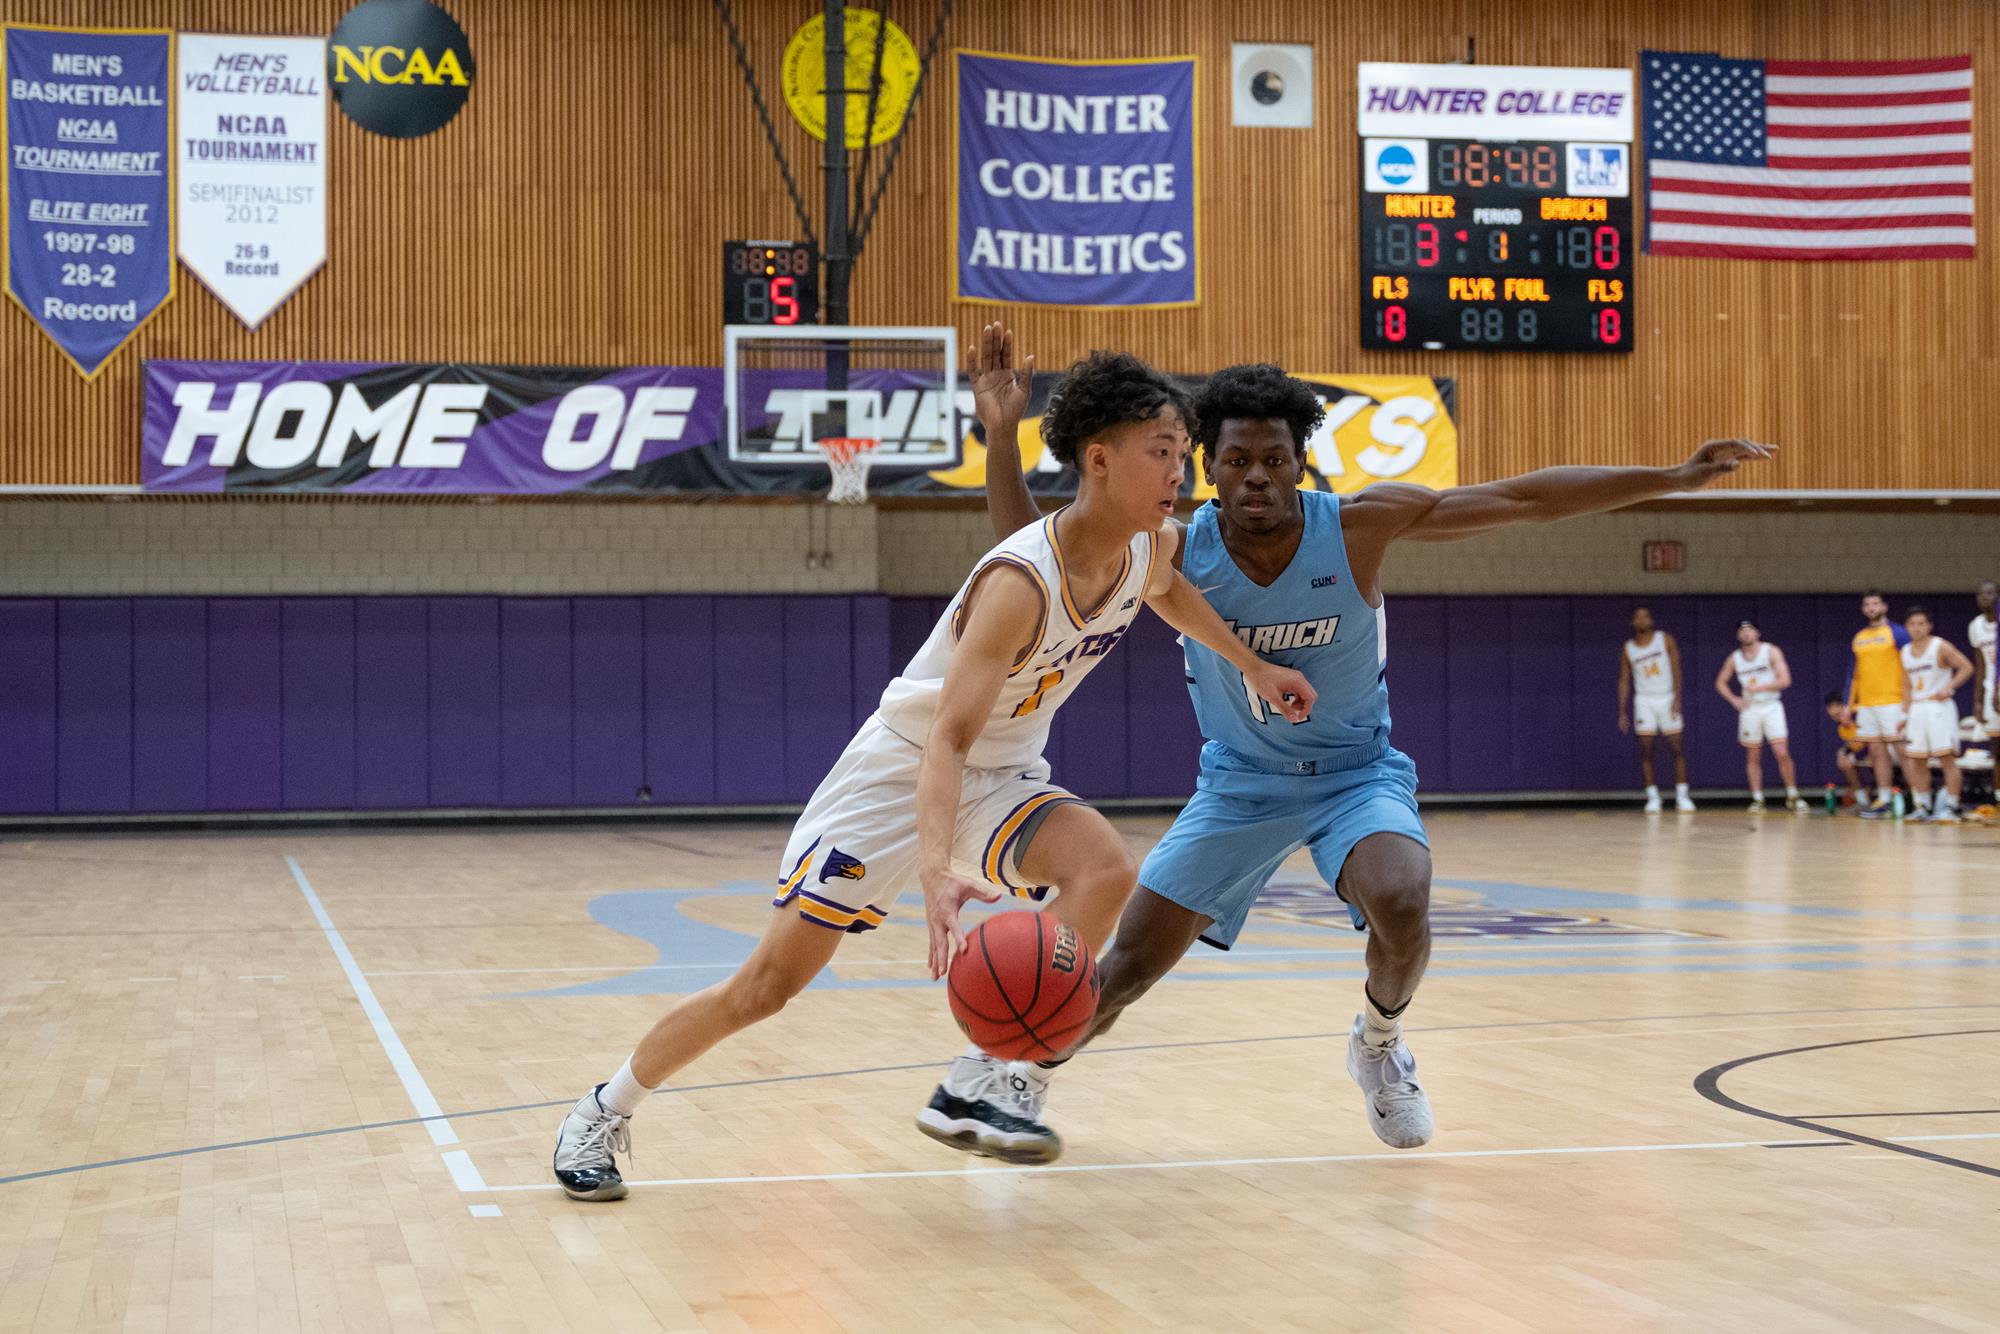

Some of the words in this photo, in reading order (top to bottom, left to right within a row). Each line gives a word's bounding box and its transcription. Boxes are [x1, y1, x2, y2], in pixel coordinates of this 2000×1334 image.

[52, 53, 123, 77] MEN'S
[214, 53, 289, 74] MEN'S
[331, 44, 471, 88] NCAA
[11, 78, 163, 107] BASKETBALL
[185, 73, 319, 96] VOLLEYBALL
[984, 88, 1170, 134] HUNTER
[1366, 86, 1487, 114] HUNTER
[1494, 90, 1625, 117] COLLEGE
[57, 117, 118, 144] NCAA
[217, 113, 288, 136] NCAA
[12, 144, 162, 176] TOURNAMENT
[186, 139, 318, 165] TOURNAMENT
[979, 158, 1176, 203] COLLEGE
[188, 182, 316, 206] SEMIFINALIST
[28, 198, 85, 223] ELITE
[87, 202, 149, 227] EIGHT
[224, 203, 280, 225] 2012
[1385, 195, 1456, 219] HUNTER
[1473, 207, 1523, 226] PERIOD
[1540, 198, 1608, 221] BARUCH
[43, 231, 136, 255] 1997-98
[968, 227, 1187, 276] ATHLETICS
[61, 262, 117, 288] 28-2
[224, 260, 280, 277] Record
[770, 275, 800, 325] 5
[1372, 276, 1409, 300] FLS
[1448, 277, 1496, 301] PLYR
[1503, 277, 1550, 301] FOUL
[1587, 279, 1624, 303] FLS
[43, 296, 137, 322] Record
[161, 381, 490, 469] HOME
[540, 384, 699, 472] OF
